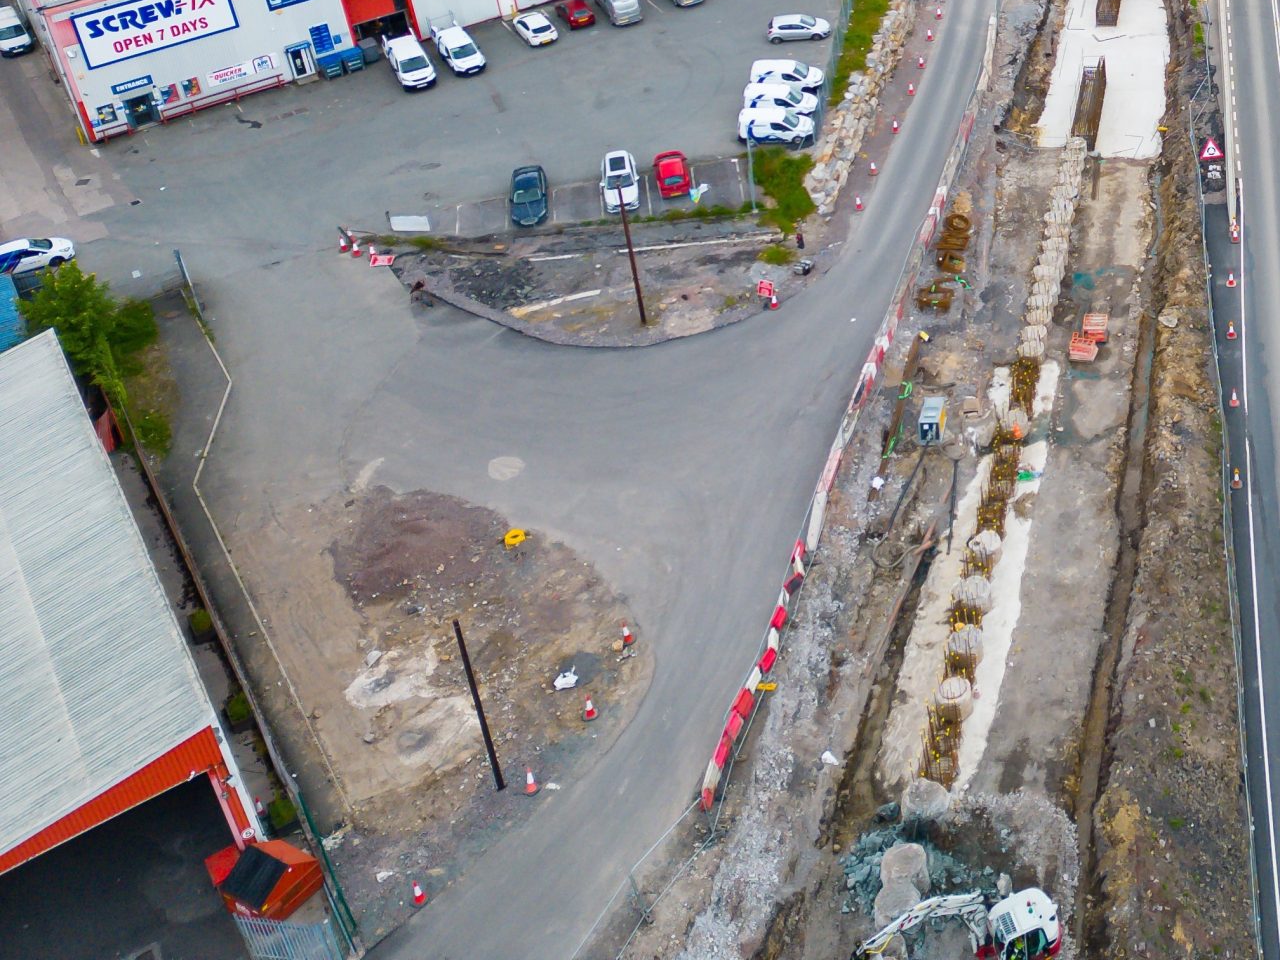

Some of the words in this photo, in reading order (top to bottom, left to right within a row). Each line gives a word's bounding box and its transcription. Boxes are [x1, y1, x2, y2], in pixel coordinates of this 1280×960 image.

[113, 33, 154, 54] OPEN
[156, 29, 165, 41] 7
[170, 17, 209, 38] DAYS
[214, 67, 242, 80] QUICKER
[116, 79, 148, 92] ENTRANCE
